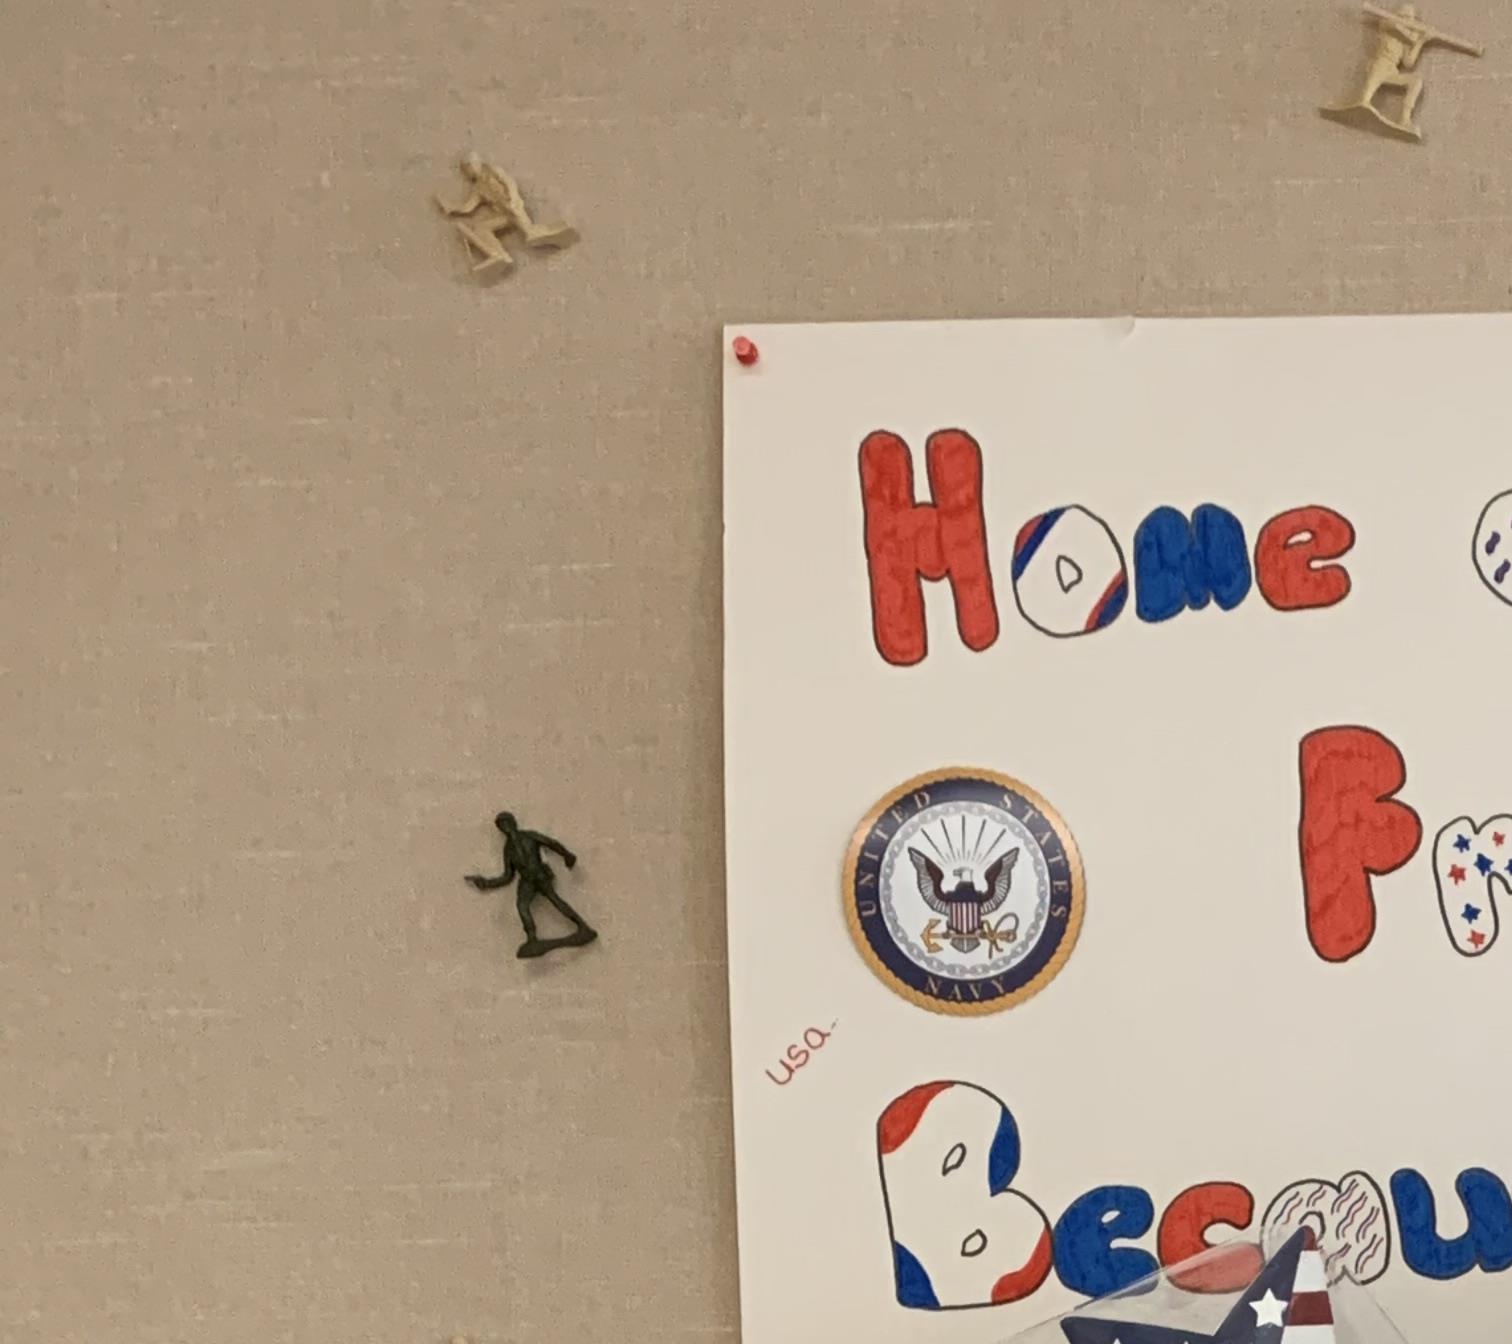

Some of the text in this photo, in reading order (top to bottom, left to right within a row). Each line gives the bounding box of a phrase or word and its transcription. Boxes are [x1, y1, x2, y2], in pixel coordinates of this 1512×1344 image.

[857, 429, 1356, 667] Home
[861, 790, 1070, 919] UNITED STATES
[925, 975, 1007, 1001] NAVY
